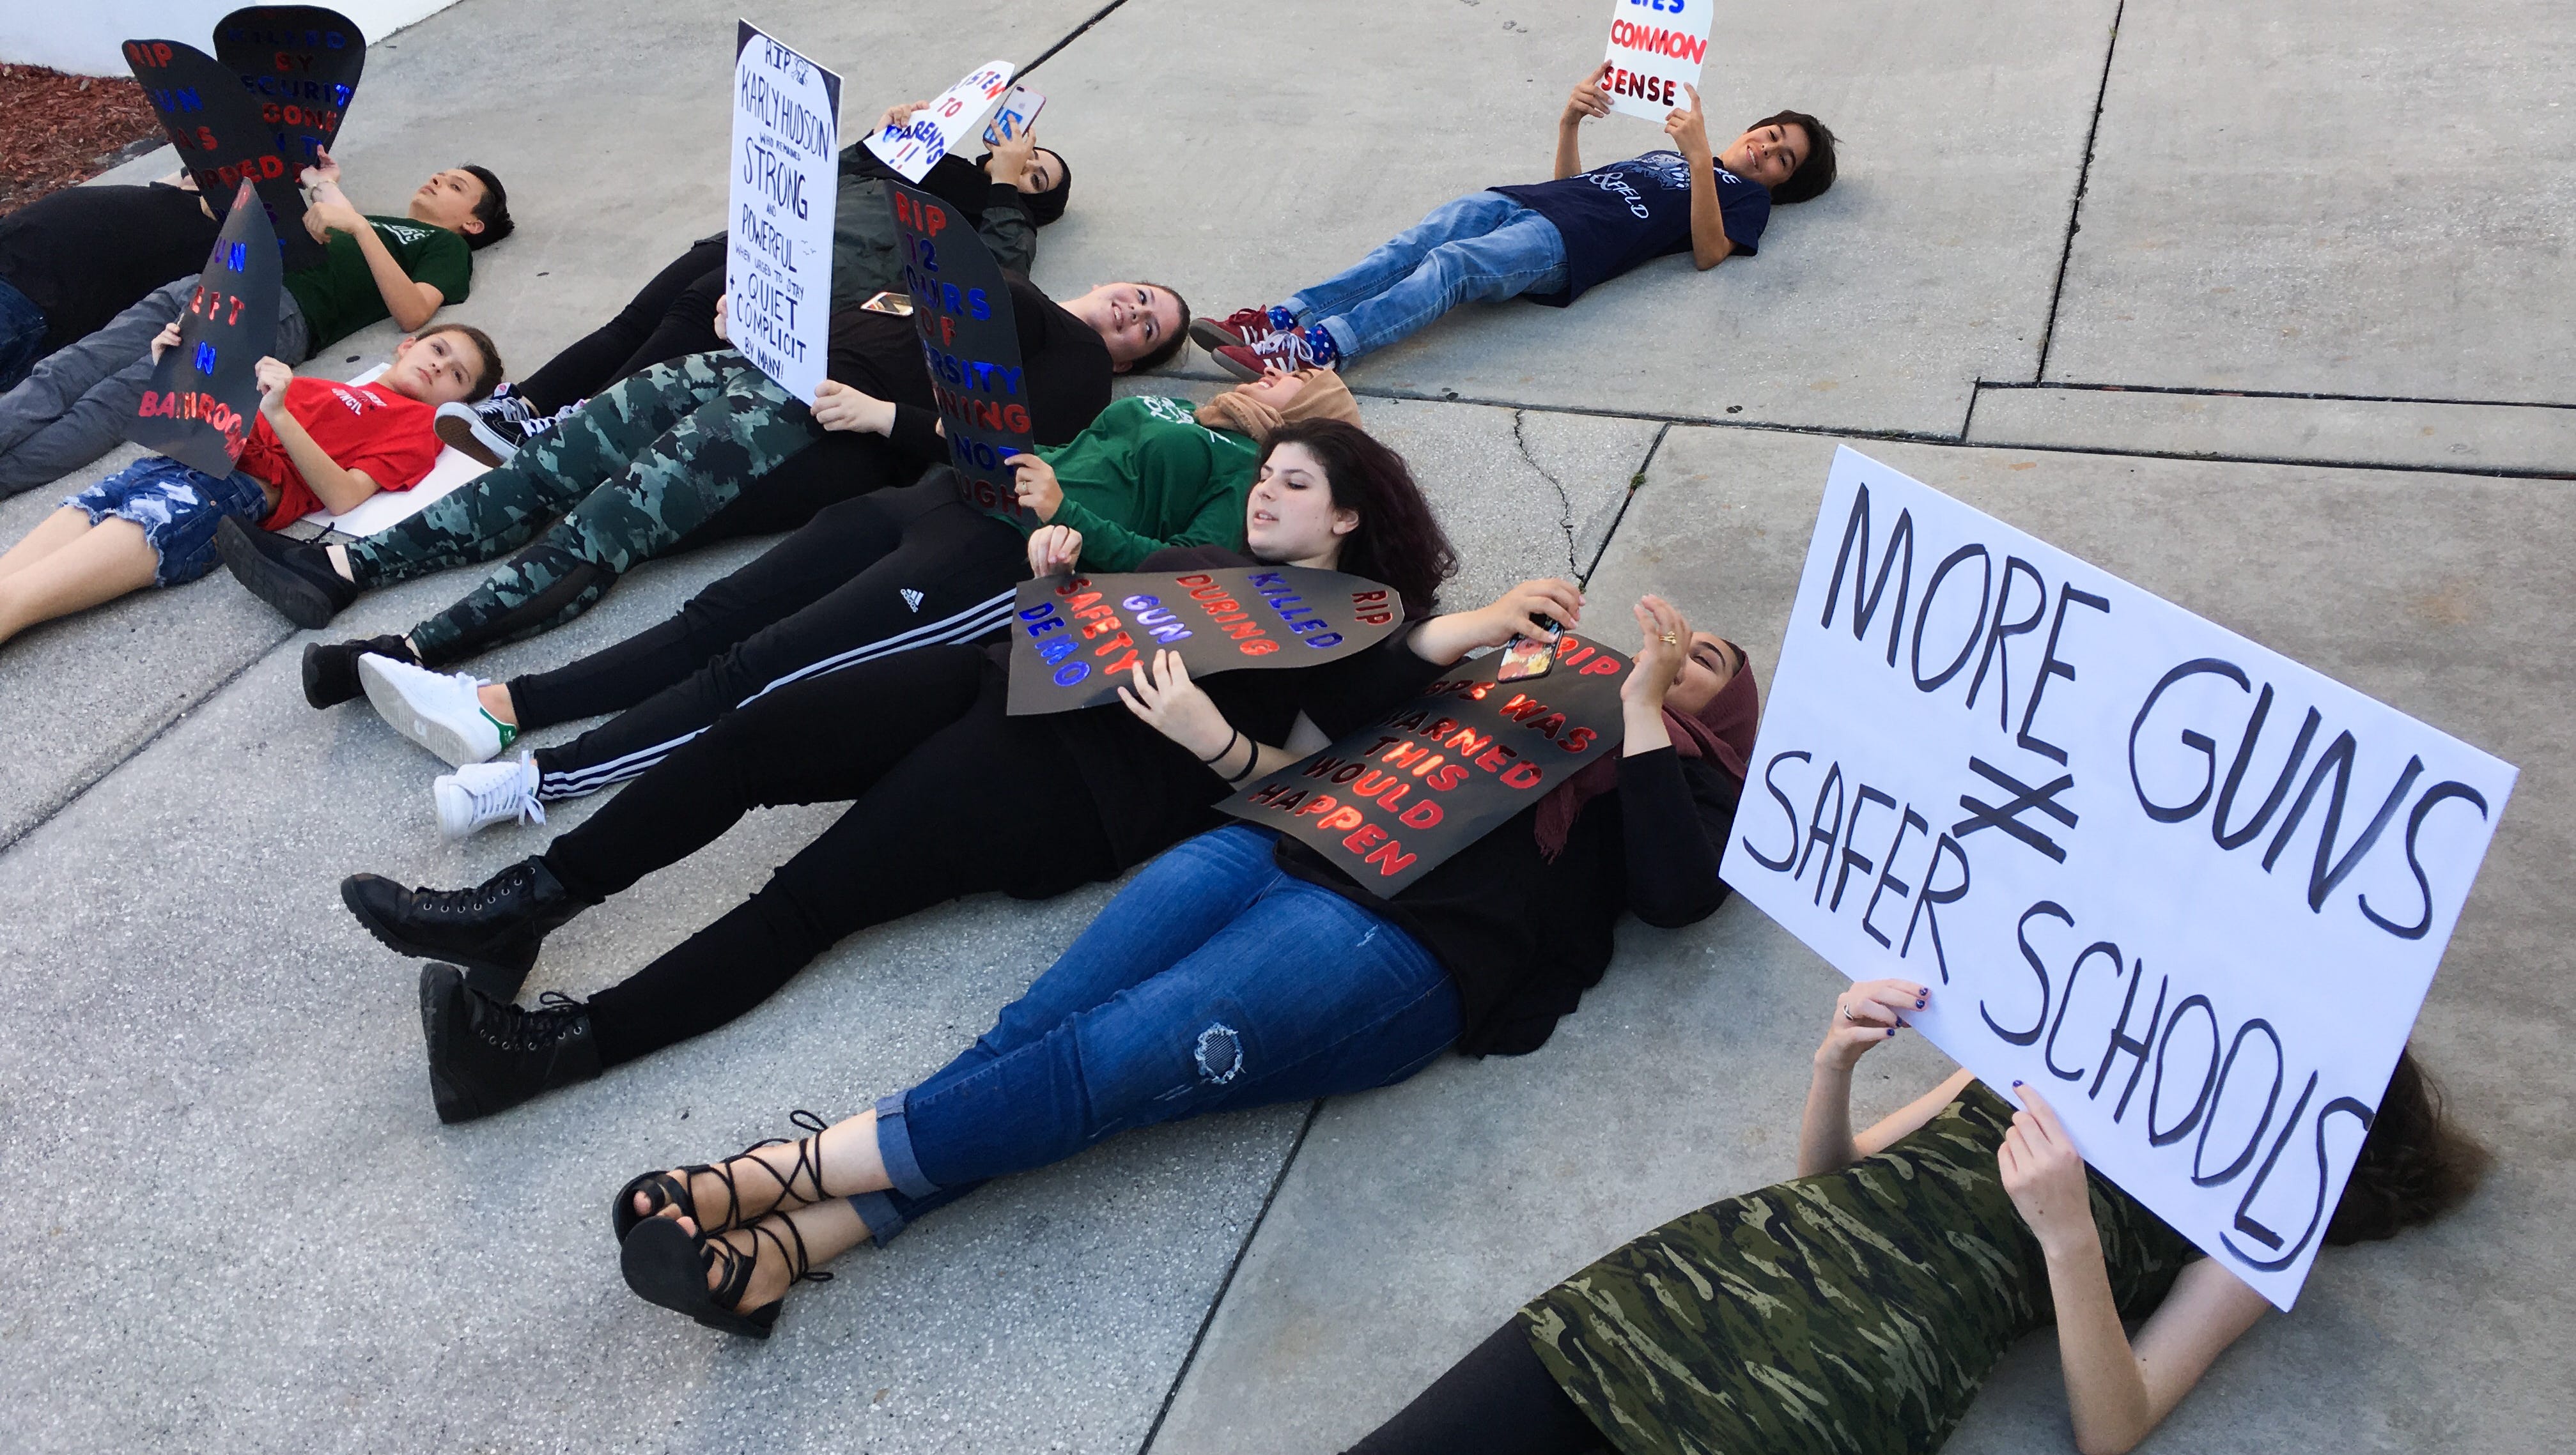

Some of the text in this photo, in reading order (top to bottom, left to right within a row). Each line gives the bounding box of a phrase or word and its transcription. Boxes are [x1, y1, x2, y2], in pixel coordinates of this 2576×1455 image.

[127, 42, 174, 68] RIP
[275, 51, 315, 72] BY
[765, 39, 791, 74] RIP
[1611, 19, 1708, 65] COMMON
[151, 86, 205, 114] UN
[741, 64, 830, 162] KARLY HUDSON
[937, 97, 963, 118] TO
[1601, 65, 1677, 107] SENSE
[760, 131, 802, 161] WHO REMAINED
[882, 120, 945, 165] PARENTS
[743, 136, 809, 221] STRONG
[742, 203, 797, 273] POWERFUL
[766, 203, 777, 217] AND
[896, 191, 947, 237] RIP
[735, 242, 804, 301] WHEN URGED TO STAY
[905, 264, 991, 321] OURS
[192, 285, 245, 326] EFT
[736, 293, 807, 364] COMPLICIT
[748, 273, 798, 331] QUIET
[920, 305, 957, 347] OF
[745, 337, 784, 380] BY MANY!
[1055, 578, 1144, 675] SAFETY
[1122, 594, 1193, 645] GUN
[1175, 574, 1280, 656] DURING
[1248, 572, 1345, 649] KILLED
[1351, 590, 1393, 626] RIP
[1018, 601, 1091, 688] DEMO
[1555, 636, 1622, 675] RIP
[1499, 693, 1597, 753] WAS
[1820, 482, 2488, 940] MORE GUNS
[1363, 735, 1470, 792] THIS
[1373, 709, 1544, 790] WARNED
[1301, 755, 1444, 830] WOULD
[1248, 781, 1418, 876] HAPPEN
[1742, 750, 2375, 1273] SAFER SCHOOLS
